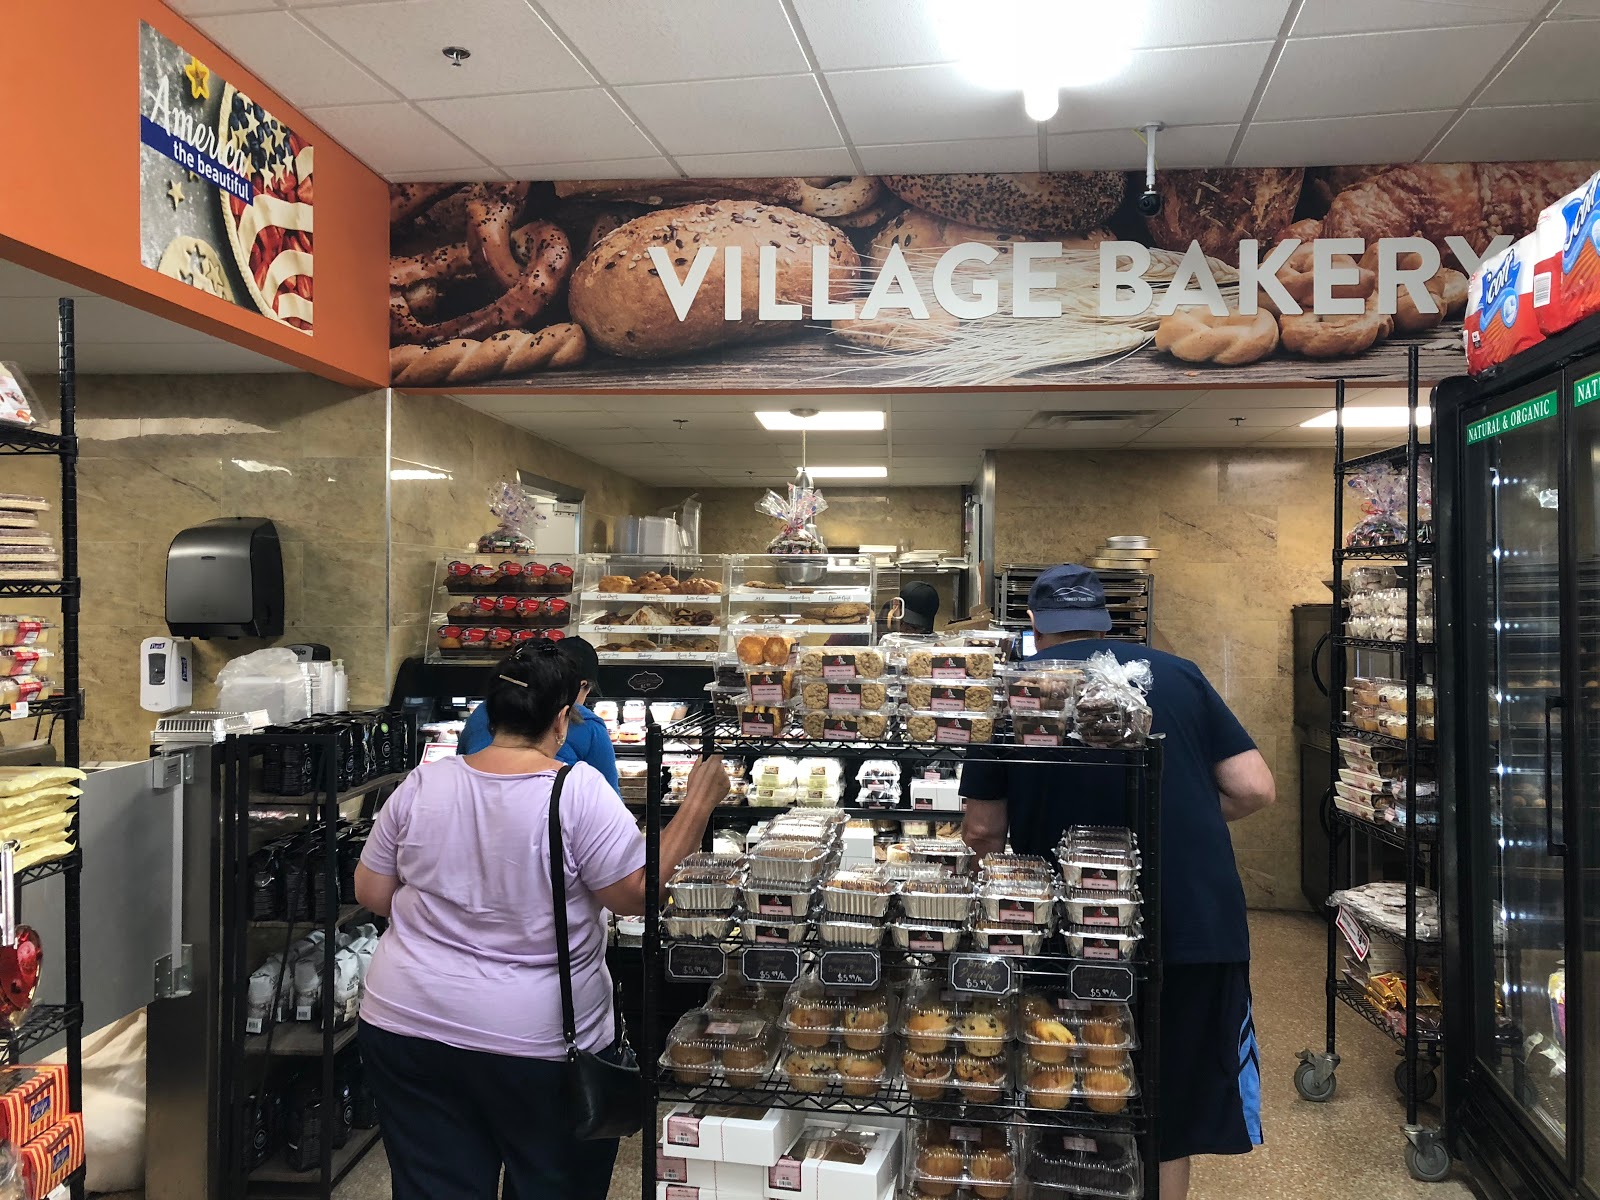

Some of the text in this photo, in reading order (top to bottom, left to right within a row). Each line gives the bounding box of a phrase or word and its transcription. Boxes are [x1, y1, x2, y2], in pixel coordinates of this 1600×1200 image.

[147, 75, 249, 177] America
[173, 140, 249, 202] the beautiful
[648, 241, 1064, 322] VILLAGE
[1468, 399, 1550, 442] NATURAL & ORGANIC
[1577, 377, 1600, 402] NAT
